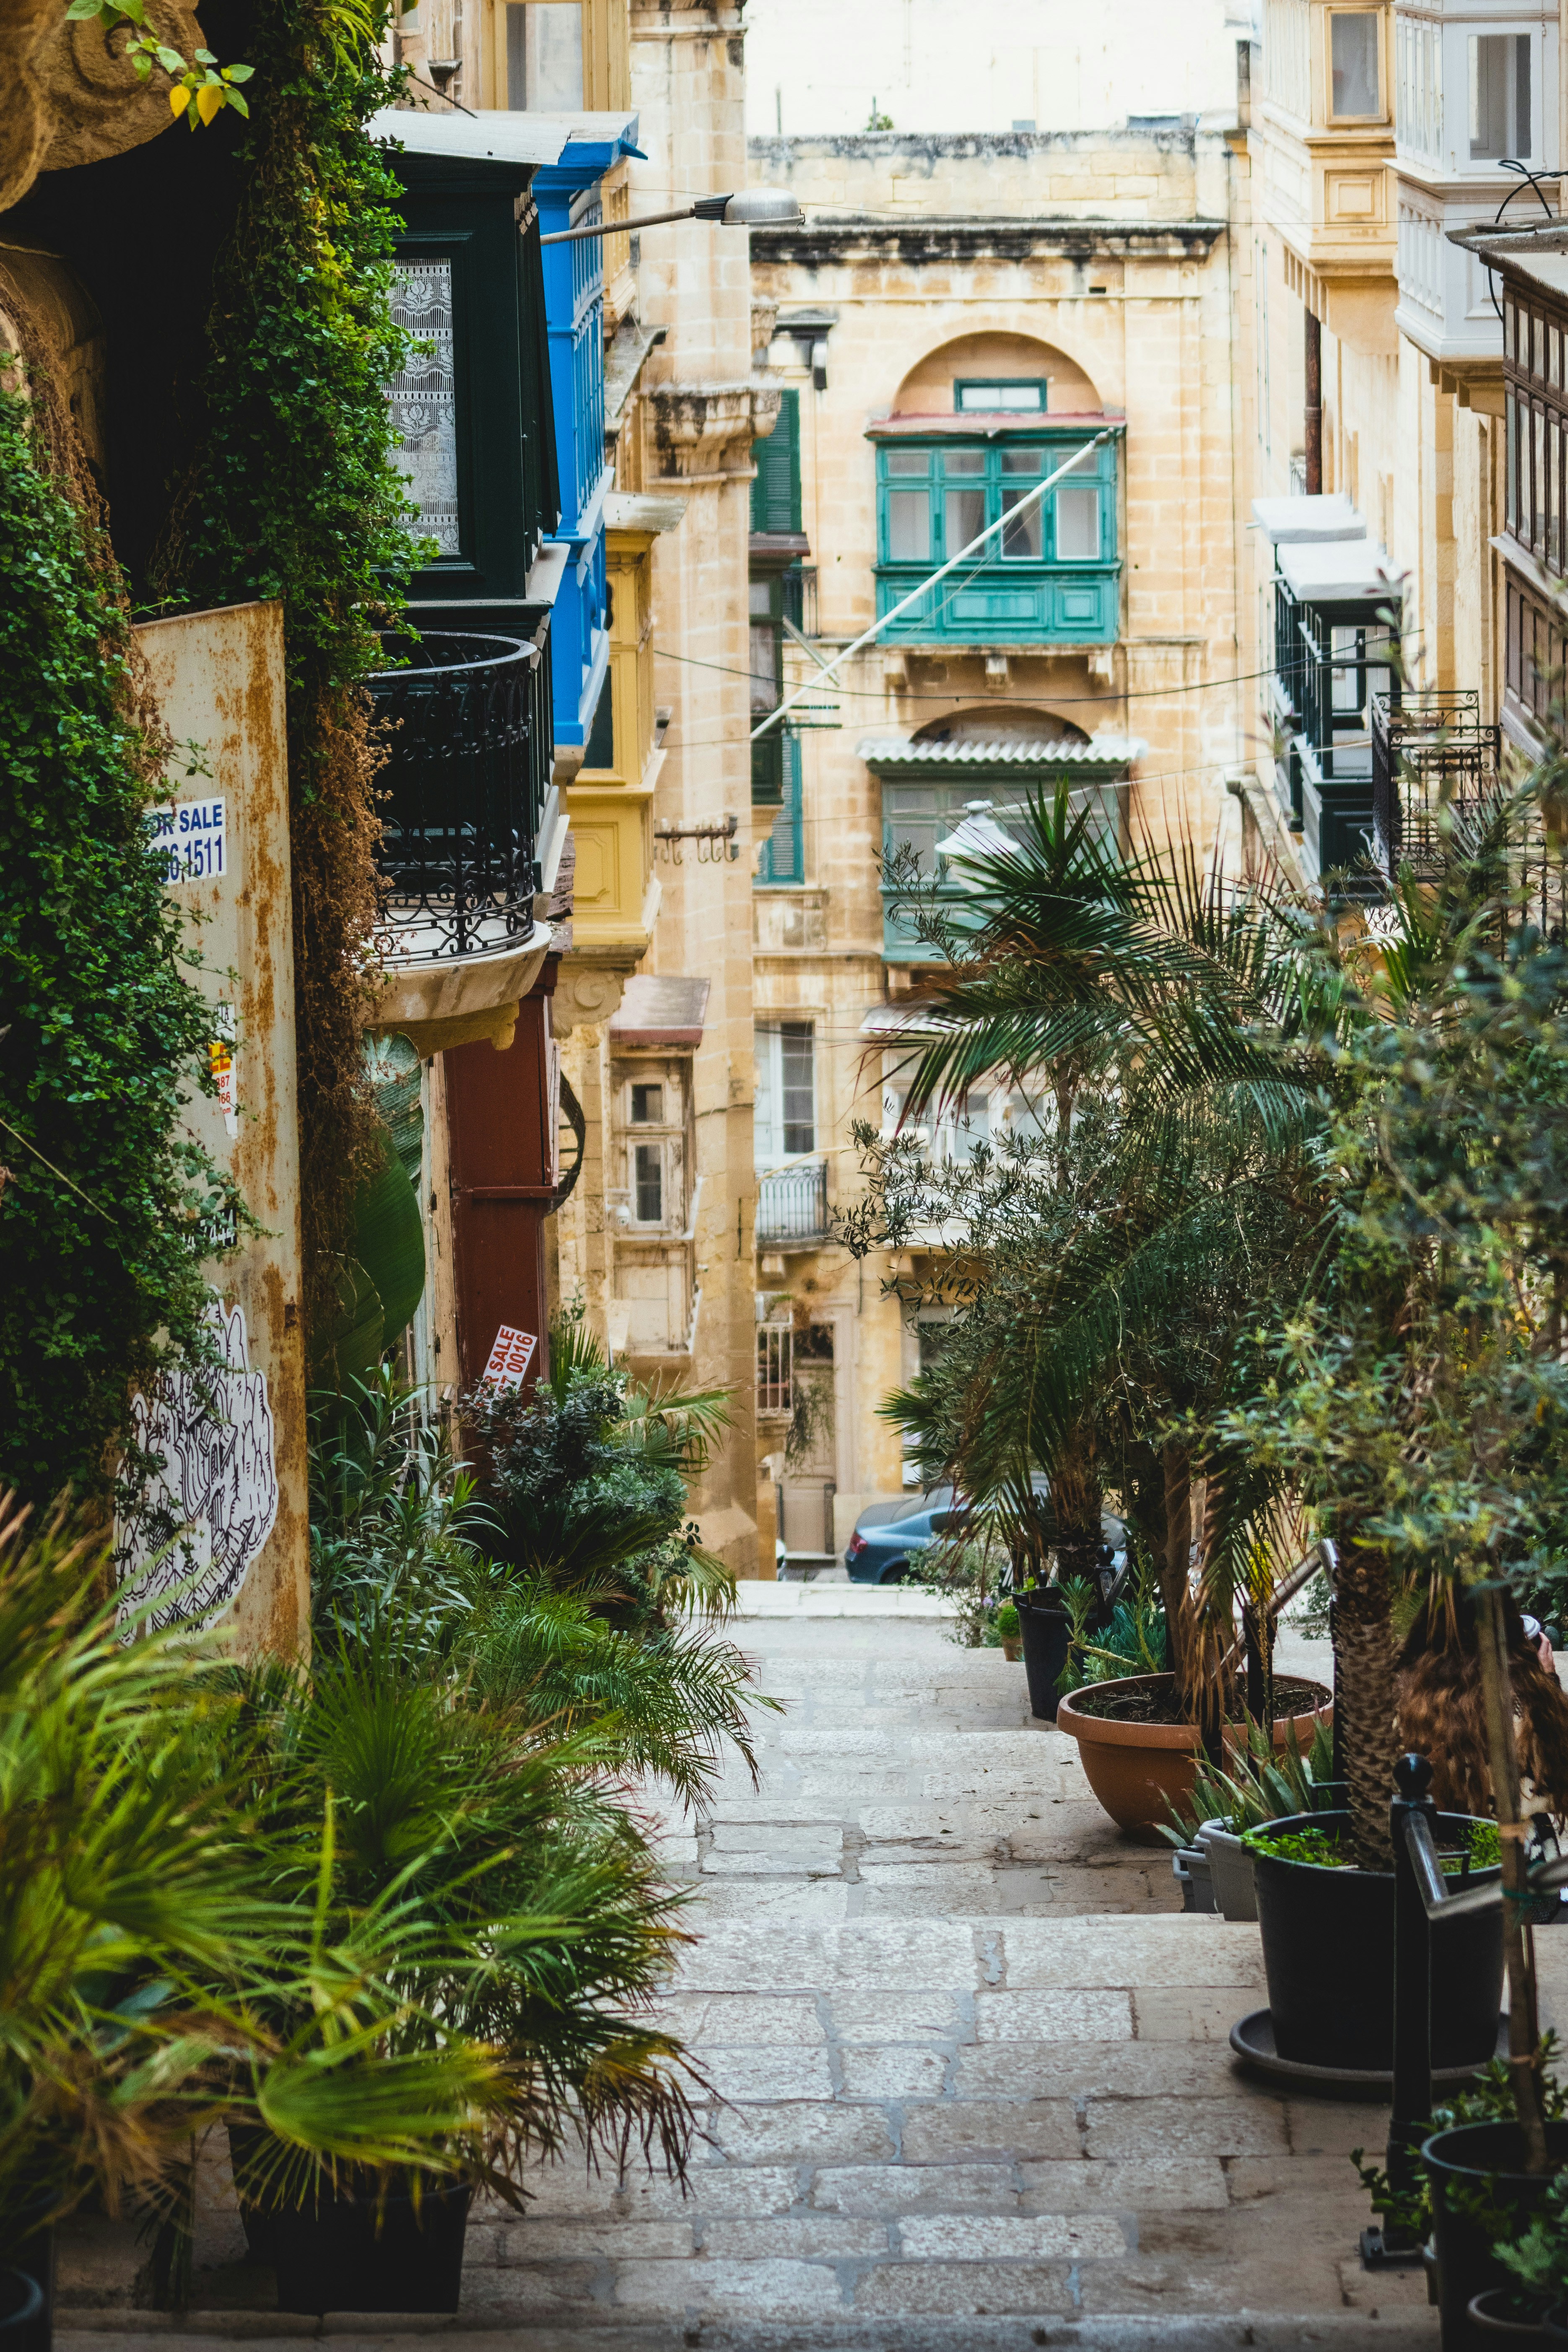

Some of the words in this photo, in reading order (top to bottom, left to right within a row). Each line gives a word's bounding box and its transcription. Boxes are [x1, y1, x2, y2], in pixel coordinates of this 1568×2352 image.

[142, 813, 174, 838] OR
[179, 804, 223, 833] SALE
[184, 834, 222, 877] 1511
[489, 1328, 515, 1372] SALE
[506, 1334, 533, 1373] 0016
